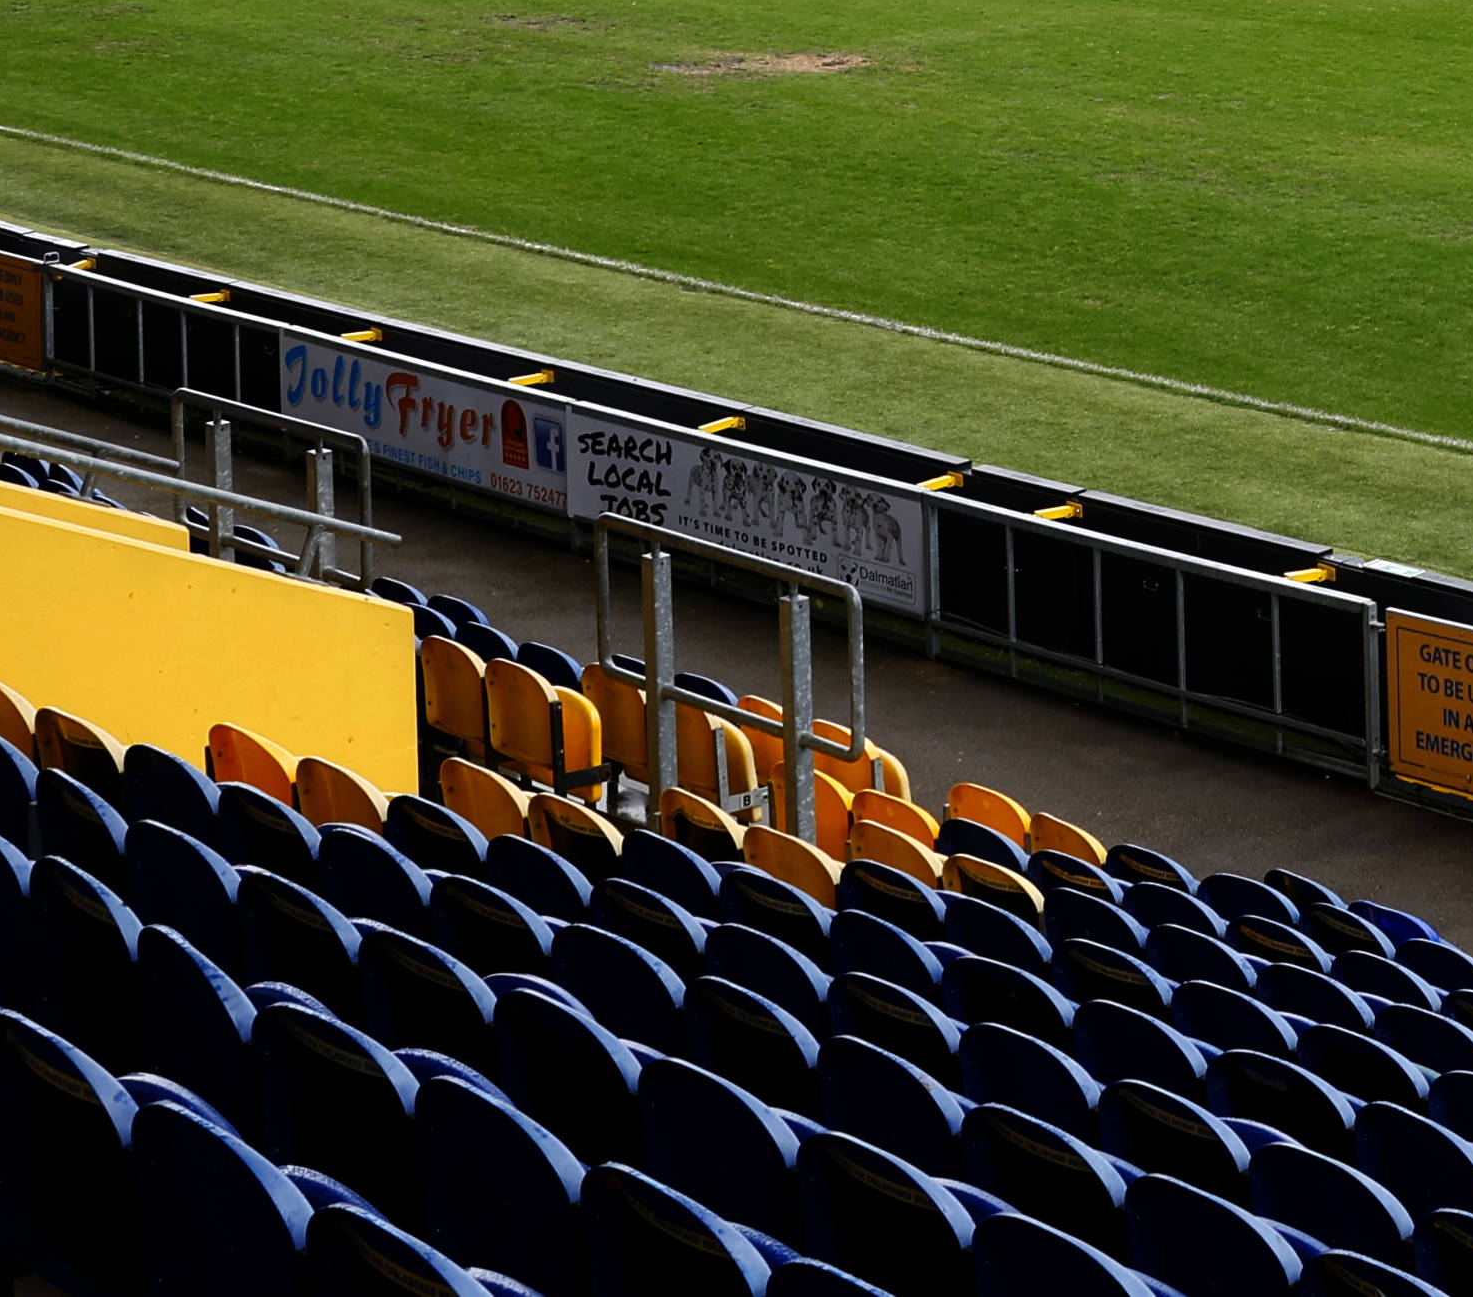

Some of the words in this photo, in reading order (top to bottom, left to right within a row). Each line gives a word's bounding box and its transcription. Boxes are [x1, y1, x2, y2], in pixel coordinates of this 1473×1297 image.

[285, 345, 382, 428] Jolly
[386, 372, 495, 448] Fryer
[384, 445, 416, 463] FINEST
[419, 453, 440, 472] FISH
[450, 463, 482, 485] CHIPS
[577, 431, 672, 465] SEARCH
[490, 473, 523, 497] 01623
[527, 483, 567, 507] 752477
[587, 462, 671, 497] LOCAL
[599, 495, 669, 527] JOBS
[679, 515, 701, 531] IT'S
[704, 521, 730, 539] TIME
[733, 529, 750, 544] TO
[753, 535, 768, 549] BE
[771, 541, 827, 563] SPOTTED
[859, 565, 913, 591] Dalmatian
[1419, 644, 1461, 671] GATE
[1417, 672, 1441, 693] TO
[1444, 680, 1464, 701] BE
[1443, 709, 1461, 728] IN
